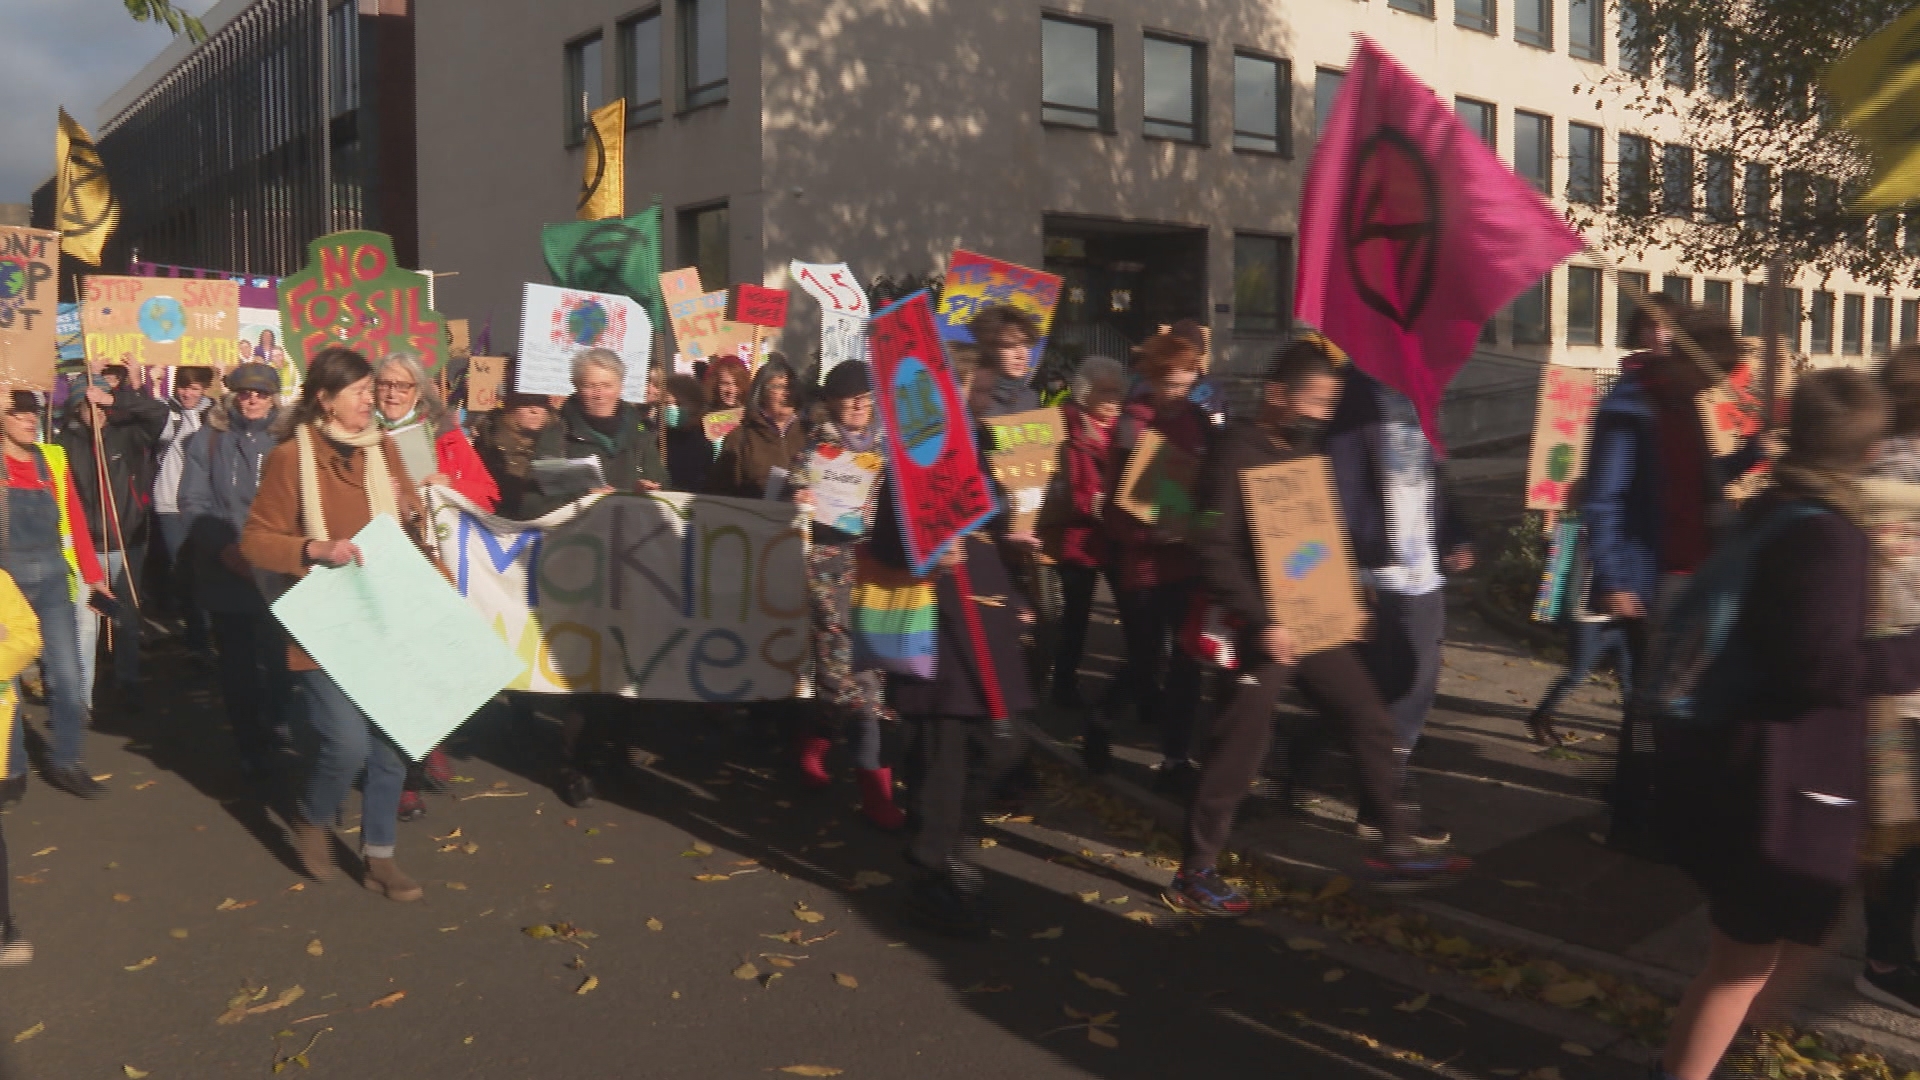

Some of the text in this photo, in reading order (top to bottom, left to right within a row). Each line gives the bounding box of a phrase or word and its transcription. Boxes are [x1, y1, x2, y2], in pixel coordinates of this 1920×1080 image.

[320, 245, 387, 291] NO
[86, 279, 142, 303] STOP
[182, 281, 234, 308] SAVE
[193, 312, 226, 331] THE
[286, 278, 438, 340] FOSSIL
[678, 311, 719, 341] ACT
[181, 336, 239, 366] EARTH
